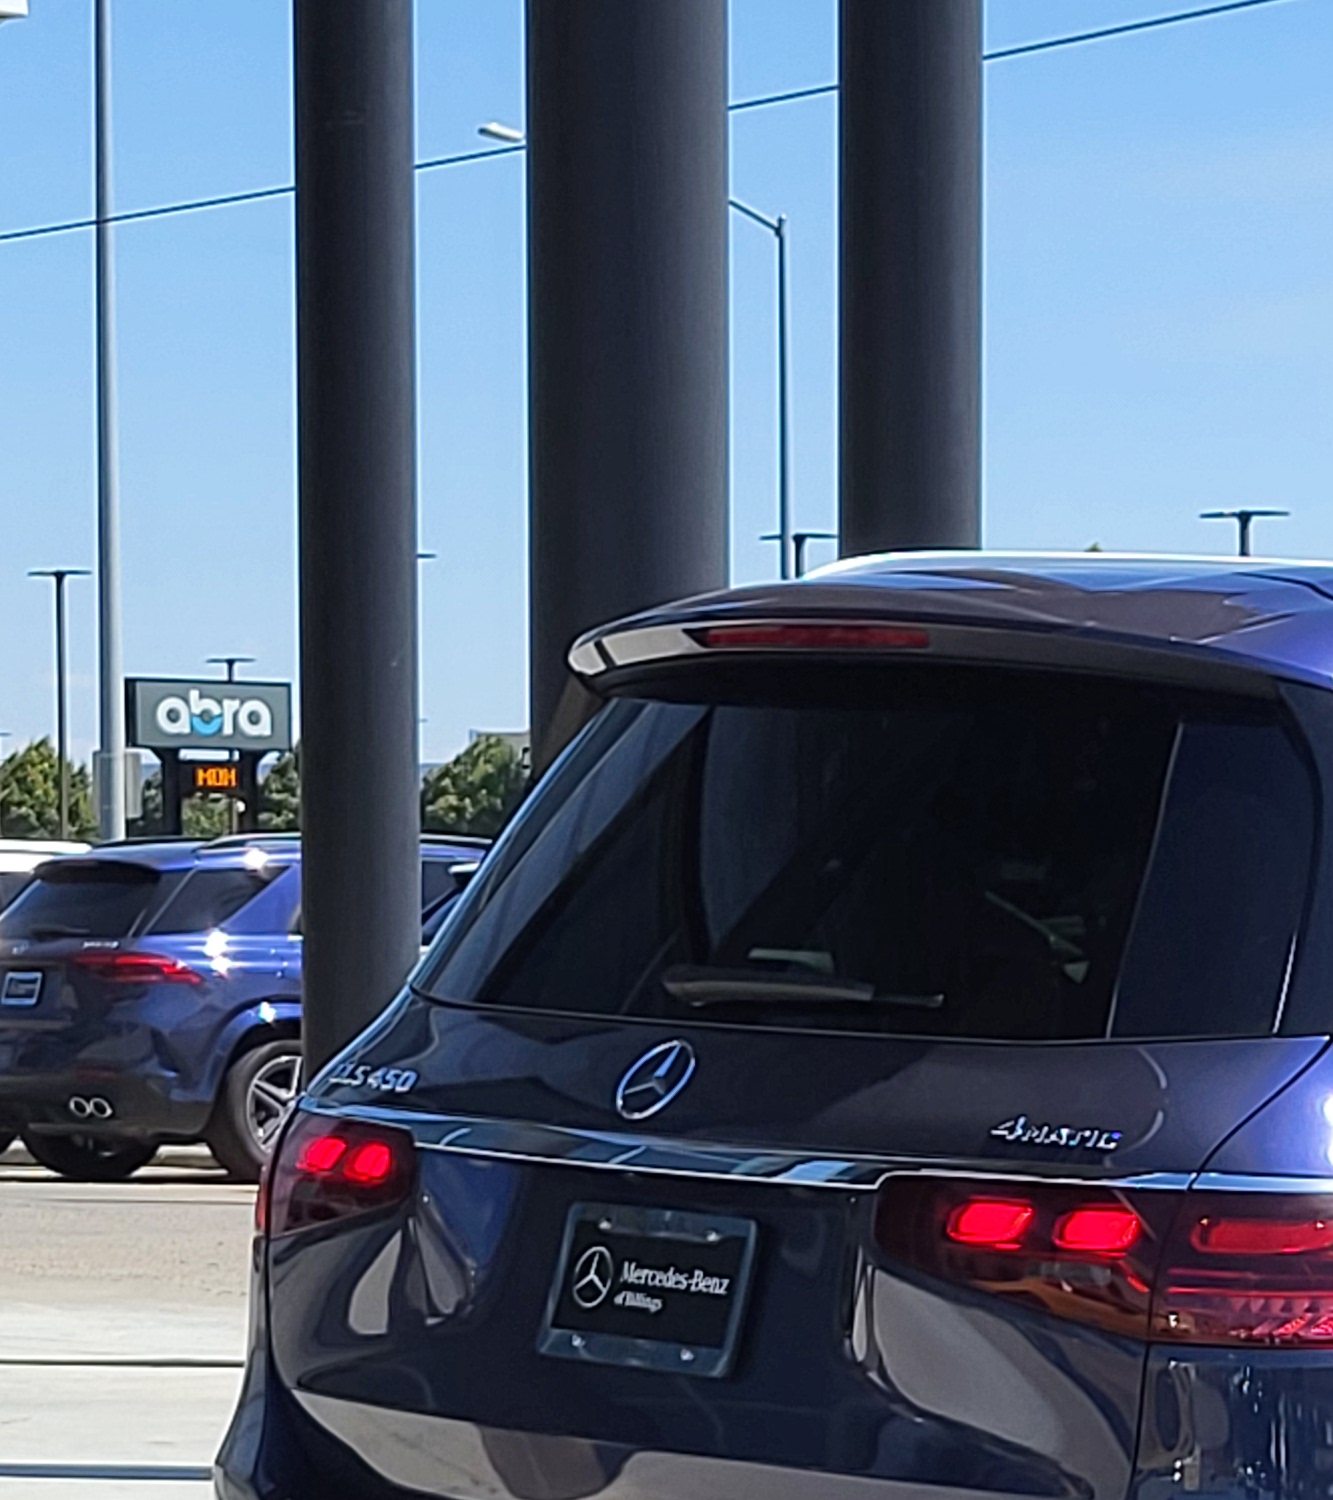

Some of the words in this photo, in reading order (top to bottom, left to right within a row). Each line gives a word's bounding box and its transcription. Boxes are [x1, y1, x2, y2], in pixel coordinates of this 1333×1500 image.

[156, 688, 273, 738] abra
[367, 1066, 418, 1093] 450
[990, 1115, 1124, 1149] 4MATIC
[620, 1260, 730, 1296] Mercedes-Benz
